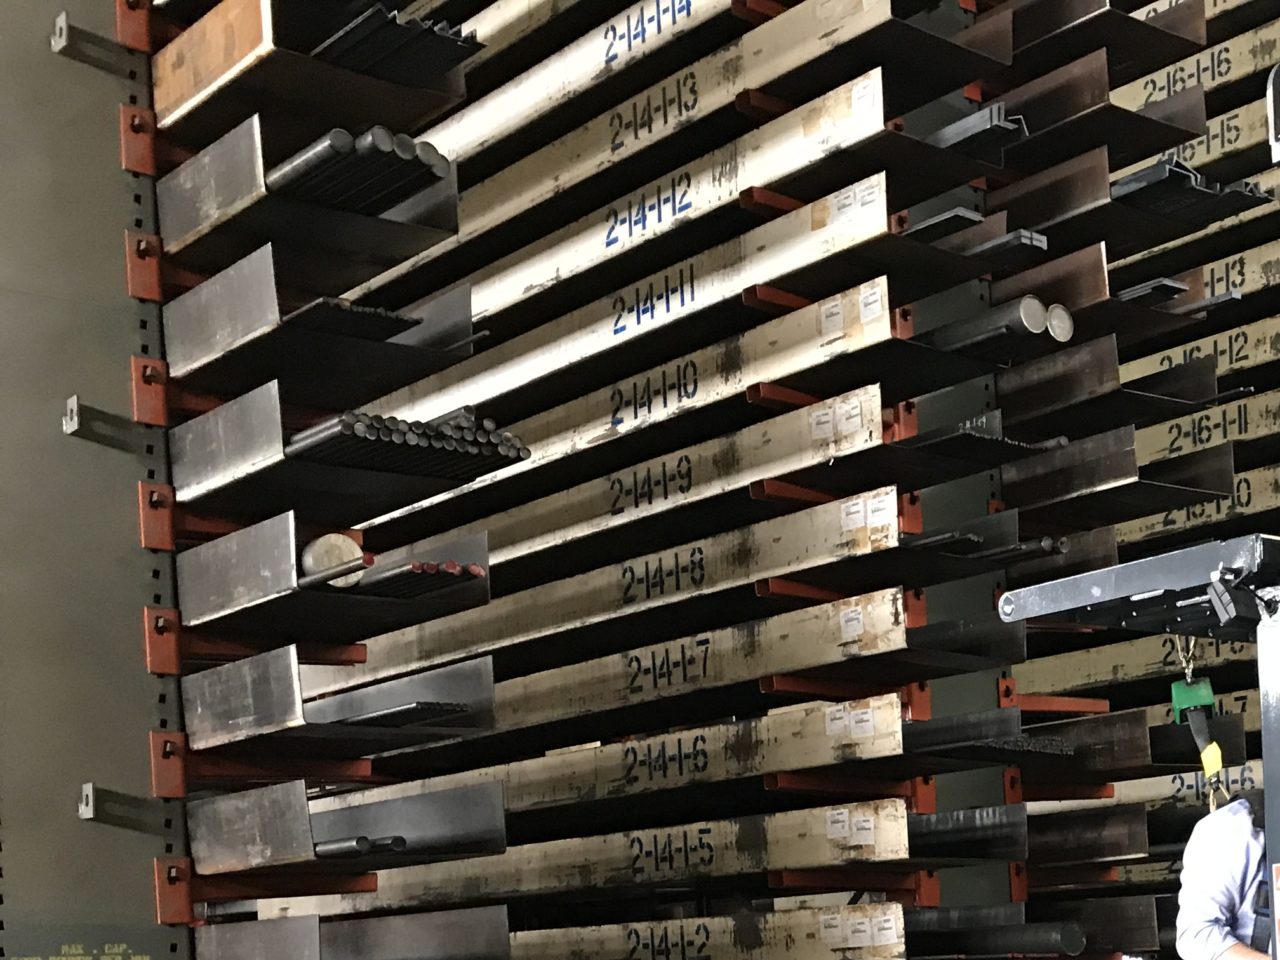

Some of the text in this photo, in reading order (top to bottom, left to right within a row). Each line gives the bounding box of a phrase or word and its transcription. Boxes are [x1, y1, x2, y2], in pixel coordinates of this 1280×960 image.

[609, 72, 698, 154] 2-14-1-13
[606, 172, 692, 247] 2-14-1-12
[612, 263, 695, 335] 2-14-1-11
[610, 360, 698, 428] 2-14-1-10
[1168, 404, 1248, 454] 2-16-1-11
[610, 454, 693, 516] 2-14-1-9
[622, 547, 705, 602] 2-14-1-8
[628, 638, 710, 694] 2-14-1-7
[625, 735, 708, 785] 2-14-1-6
[630, 828, 714, 876] 2-14-1-5
